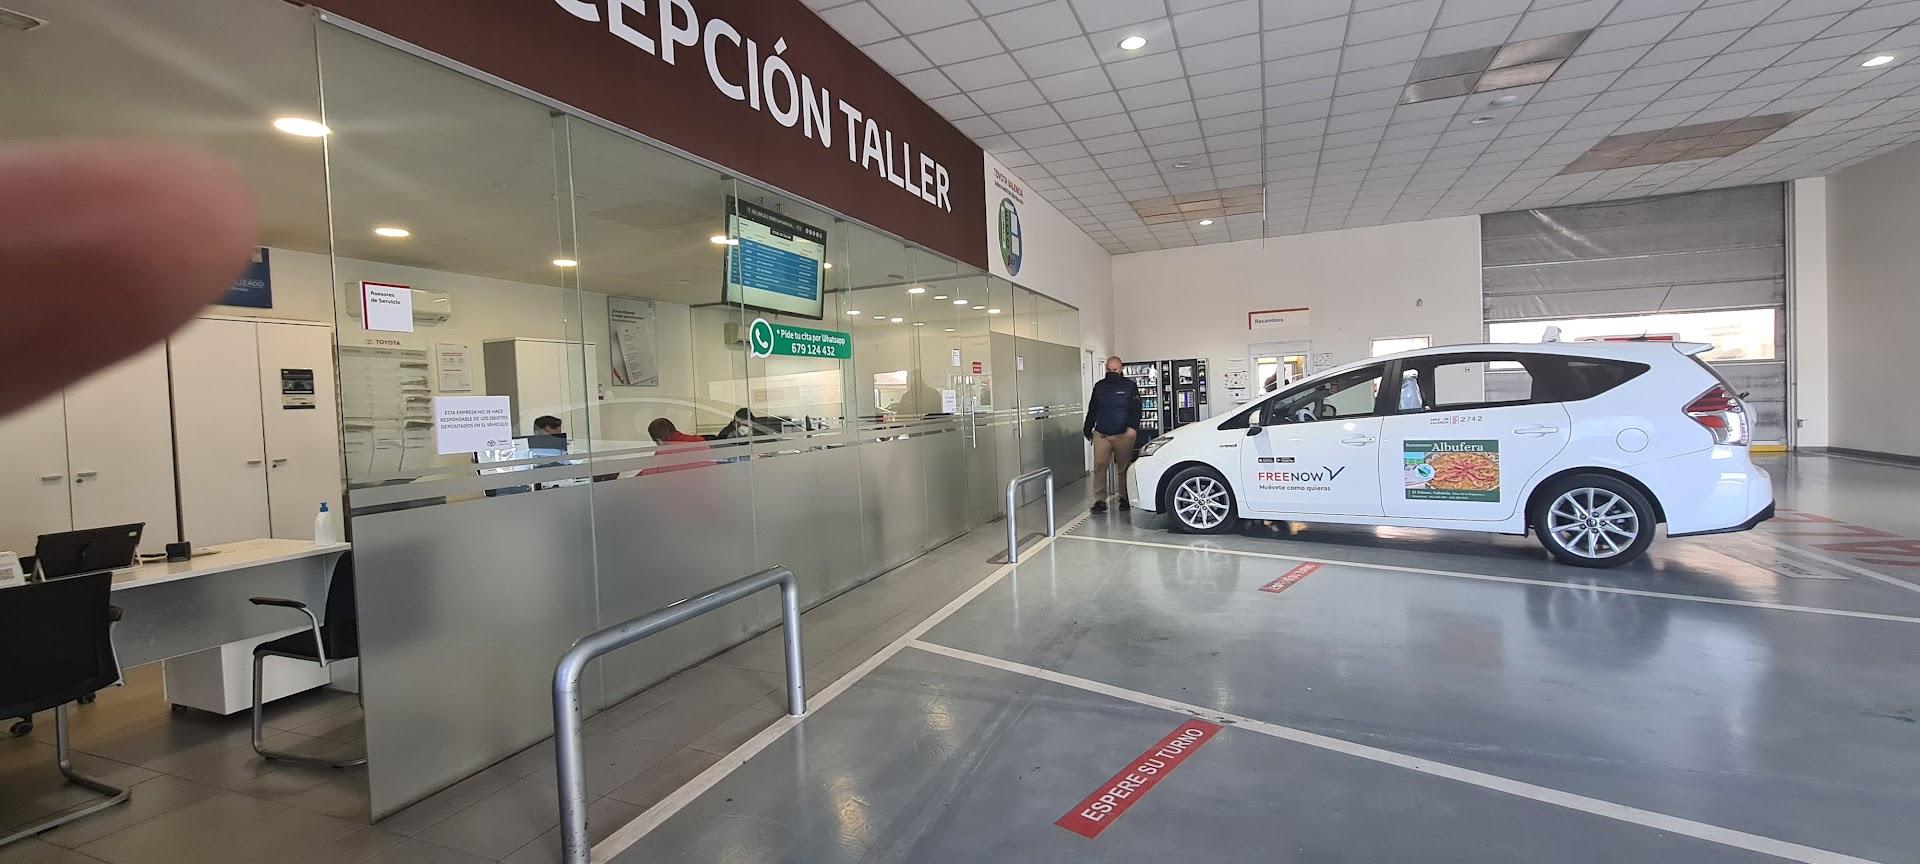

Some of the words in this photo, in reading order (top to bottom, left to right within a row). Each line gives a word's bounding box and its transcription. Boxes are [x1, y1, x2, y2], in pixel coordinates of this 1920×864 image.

[839, 98, 952, 214] TALLER
[370, 290, 395, 298] Asesores
[780, 329, 794, 340] Pide
[794, 331, 801, 340] tu
[801, 331, 812, 341] cita
[812, 334, 821, 343] por
[821, 334, 846, 346] Whatsapp
[791, 342, 806, 354] 679
[807, 344, 821, 355] 124
[821, 345, 836, 356] 432
[1460, 415, 1483, 423] 2742
[1431, 442, 1484, 452] Albufera
[1080, 773, 1148, 822] ESPERE
[1137, 758, 1166, 775] SU
[1155, 728, 1204, 759] TURNO
